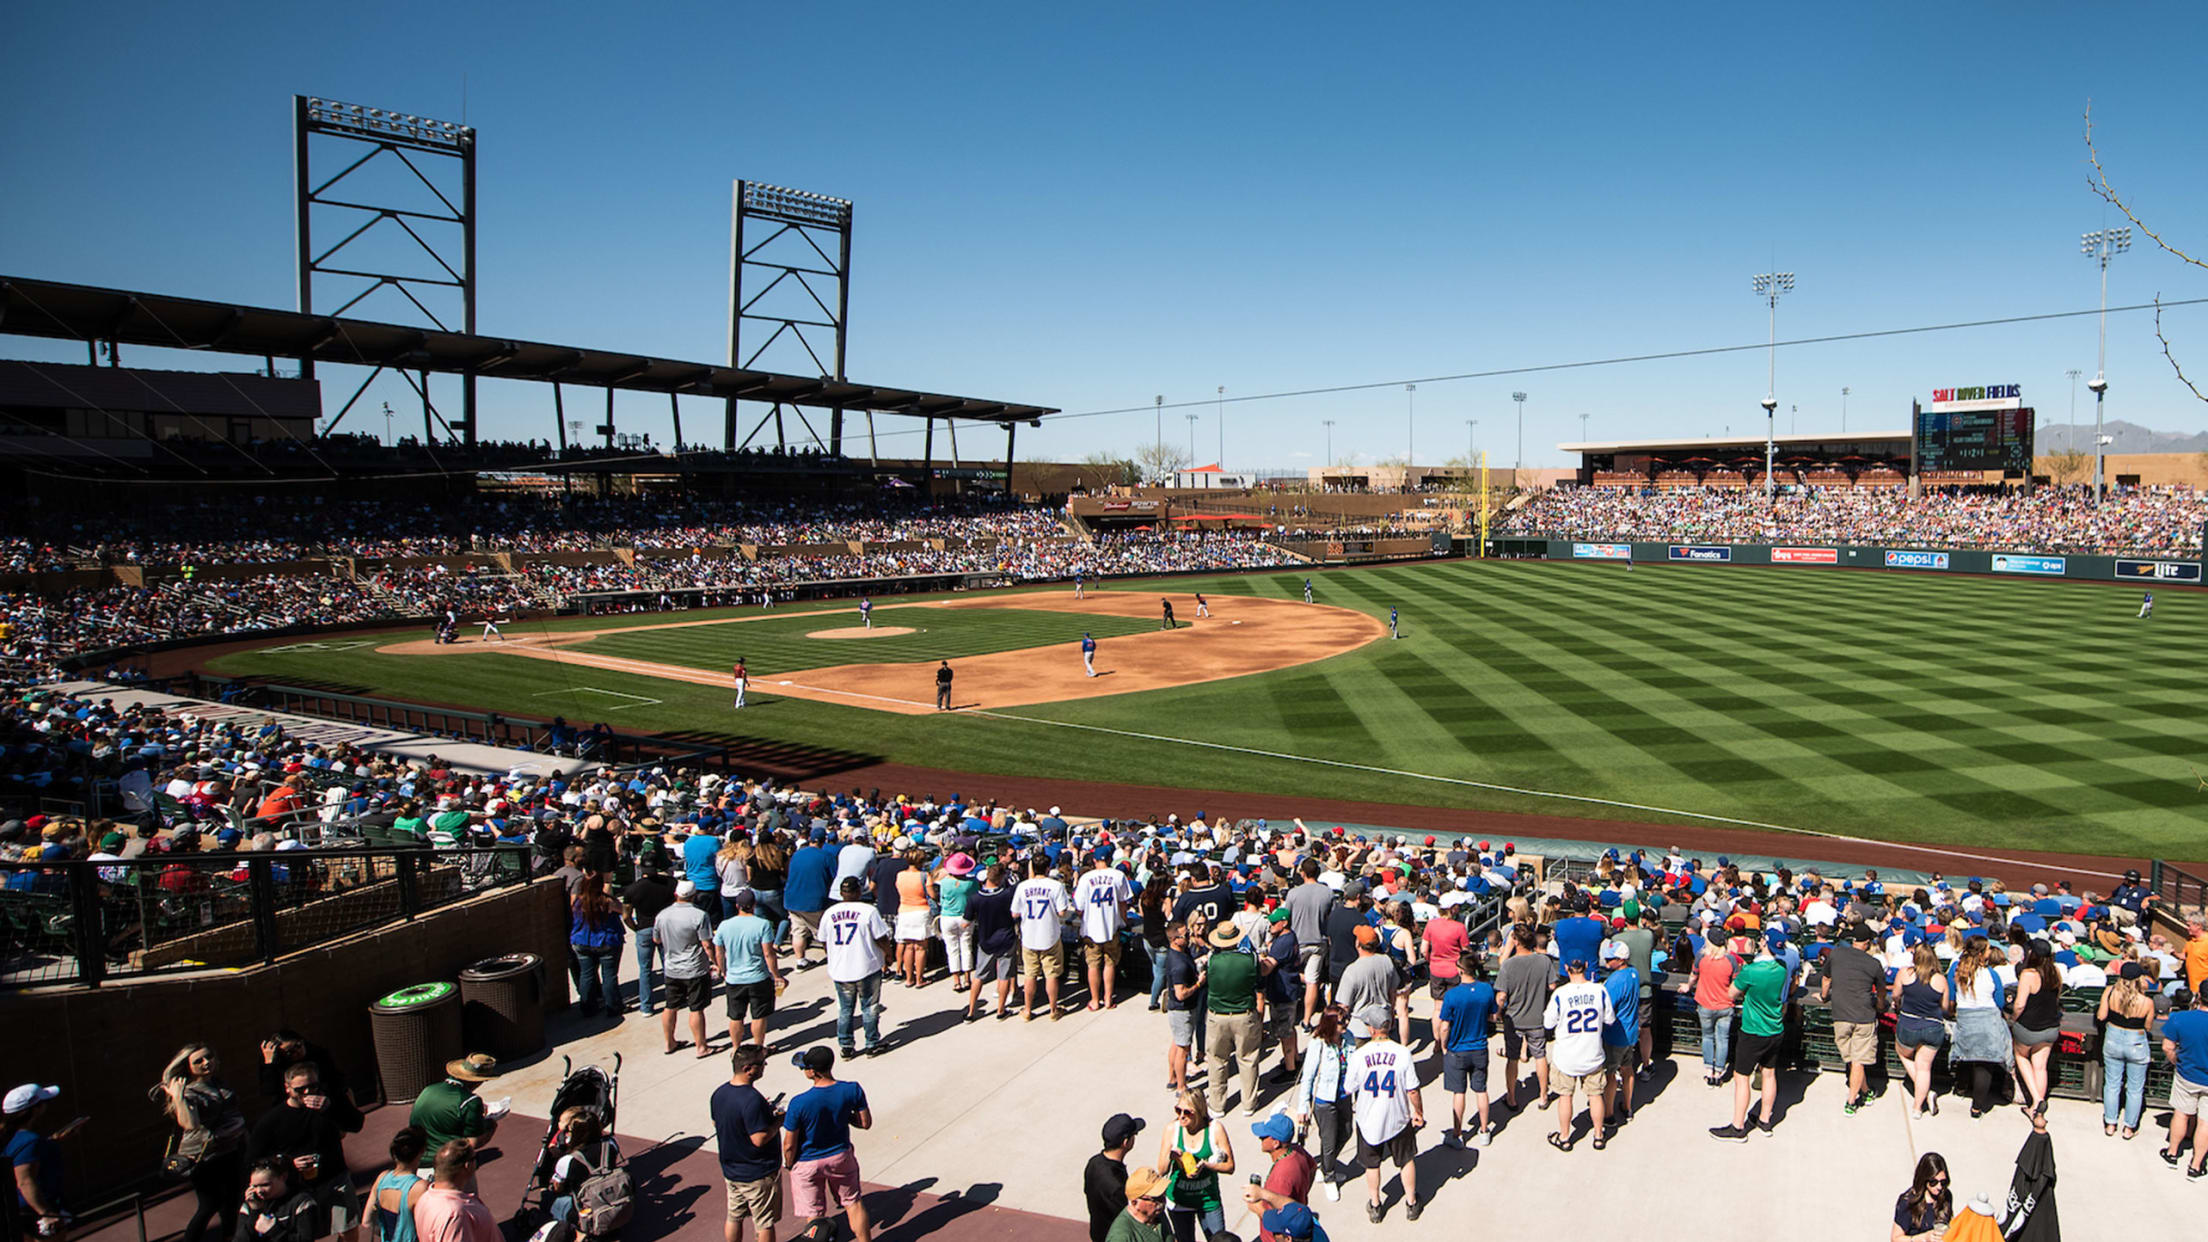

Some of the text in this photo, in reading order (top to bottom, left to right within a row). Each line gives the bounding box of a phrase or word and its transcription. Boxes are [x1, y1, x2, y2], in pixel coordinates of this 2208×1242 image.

[1933, 384, 2021, 402] SALT RIVER FIELDS
[1690, 550, 1720, 559] Fanatics
[1899, 553, 1932, 566] pepsi
[2154, 563, 2179, 577] Lite
[1088, 875, 1114, 886] RIZZO
[1024, 887, 1051, 897] BRYANT
[1090, 886, 1114, 908] 44
[831, 910, 861, 923] BRYANT
[1026, 899, 1050, 920] 17
[833, 922, 858, 945] 17
[1568, 994, 1595, 1008] PRIOR
[1567, 1007, 1599, 1034] 22
[1364, 1051, 1396, 1068] RIZZO
[1364, 1069, 1396, 1098] 44
